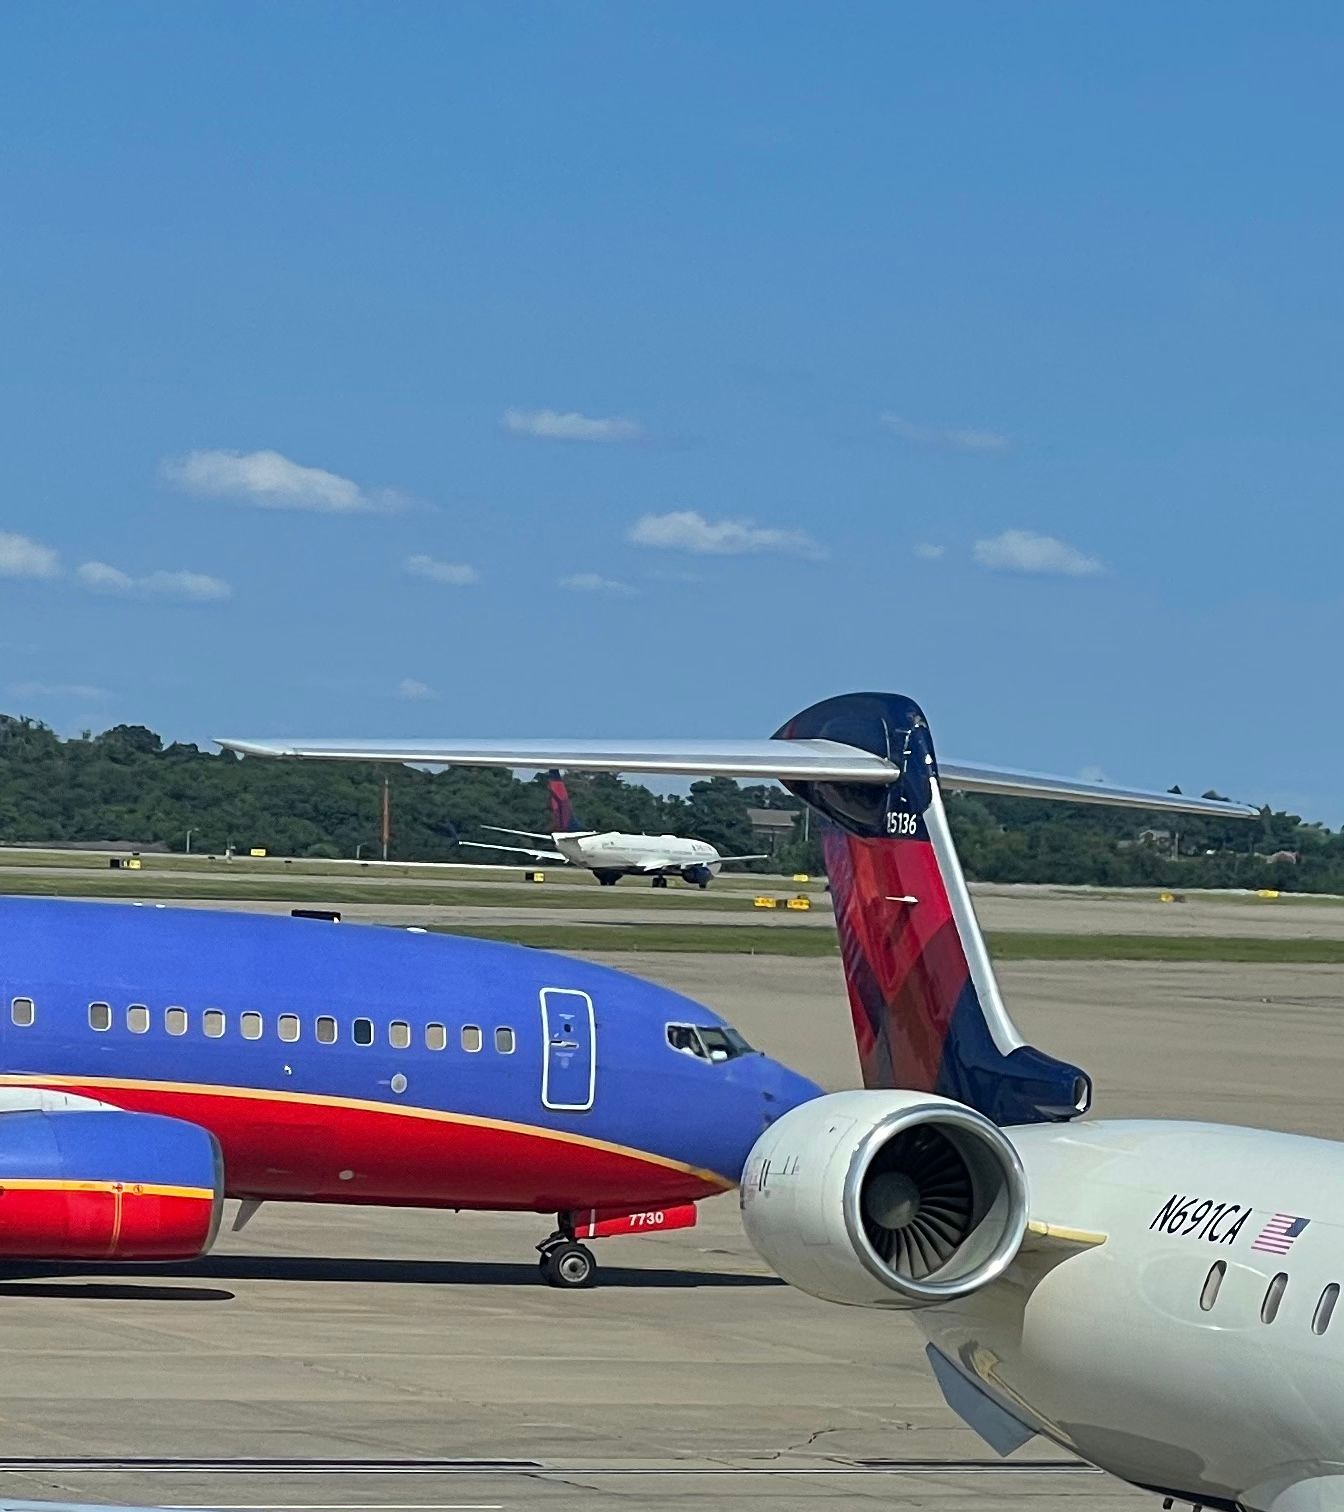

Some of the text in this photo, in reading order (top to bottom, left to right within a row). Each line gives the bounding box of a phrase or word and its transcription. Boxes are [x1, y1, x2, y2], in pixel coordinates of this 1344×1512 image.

[887, 811, 917, 834] 15136
[629, 1211, 664, 1226] 7730
[1149, 1194, 1253, 1245] N691CA
